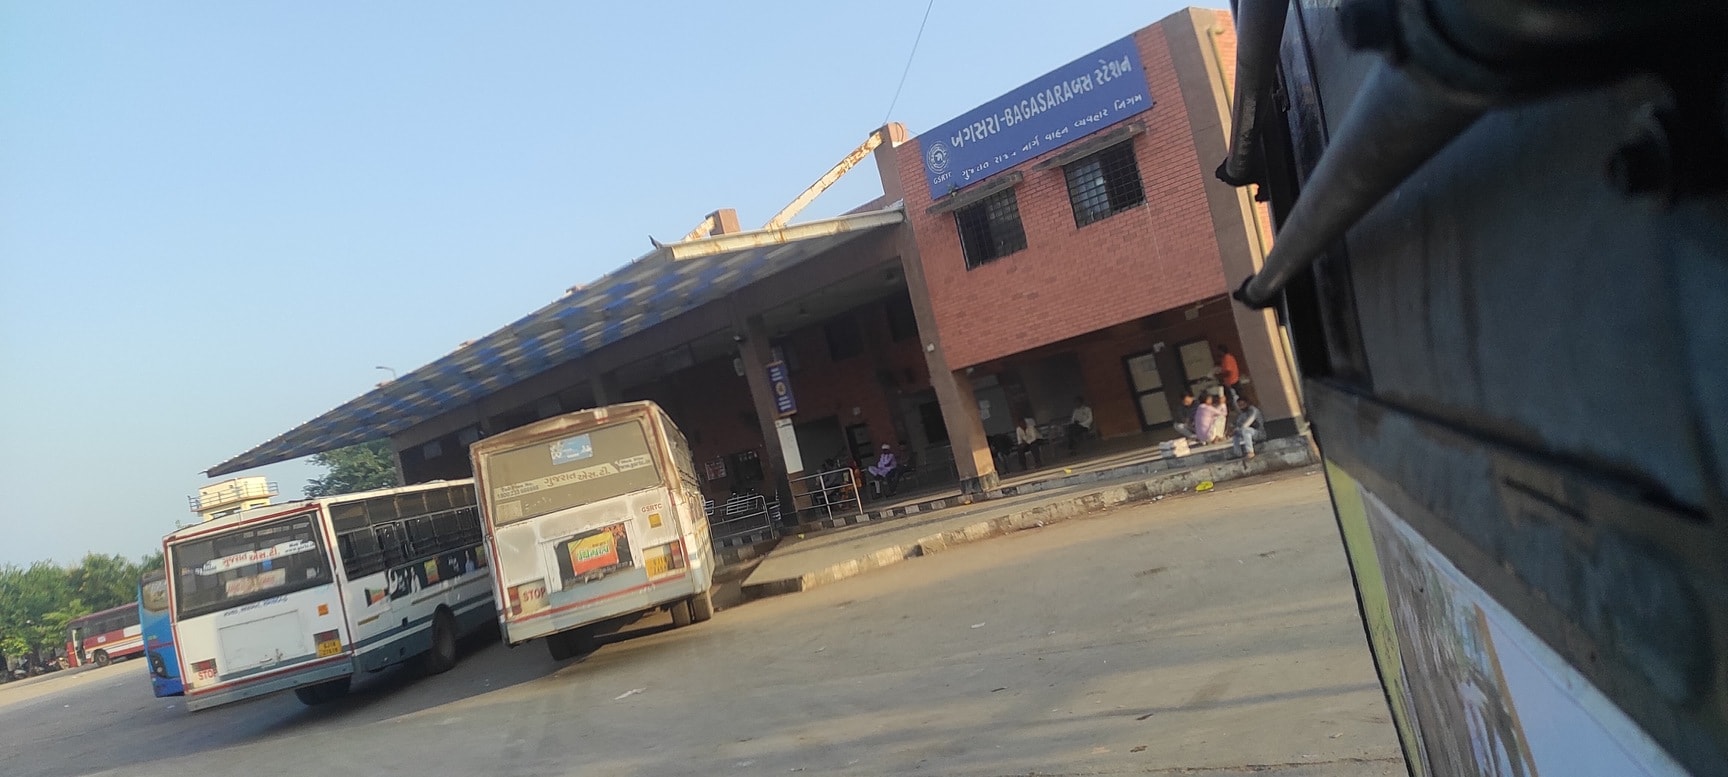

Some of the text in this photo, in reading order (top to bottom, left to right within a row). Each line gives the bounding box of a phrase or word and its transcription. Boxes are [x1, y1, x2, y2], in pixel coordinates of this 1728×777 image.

[1044, 126, 1069, 141] વાહન
[543, 472, 576, 488] ગુજરાત
[641, 503, 662, 512] GSRTC
[522, 586, 547, 602] STOP
